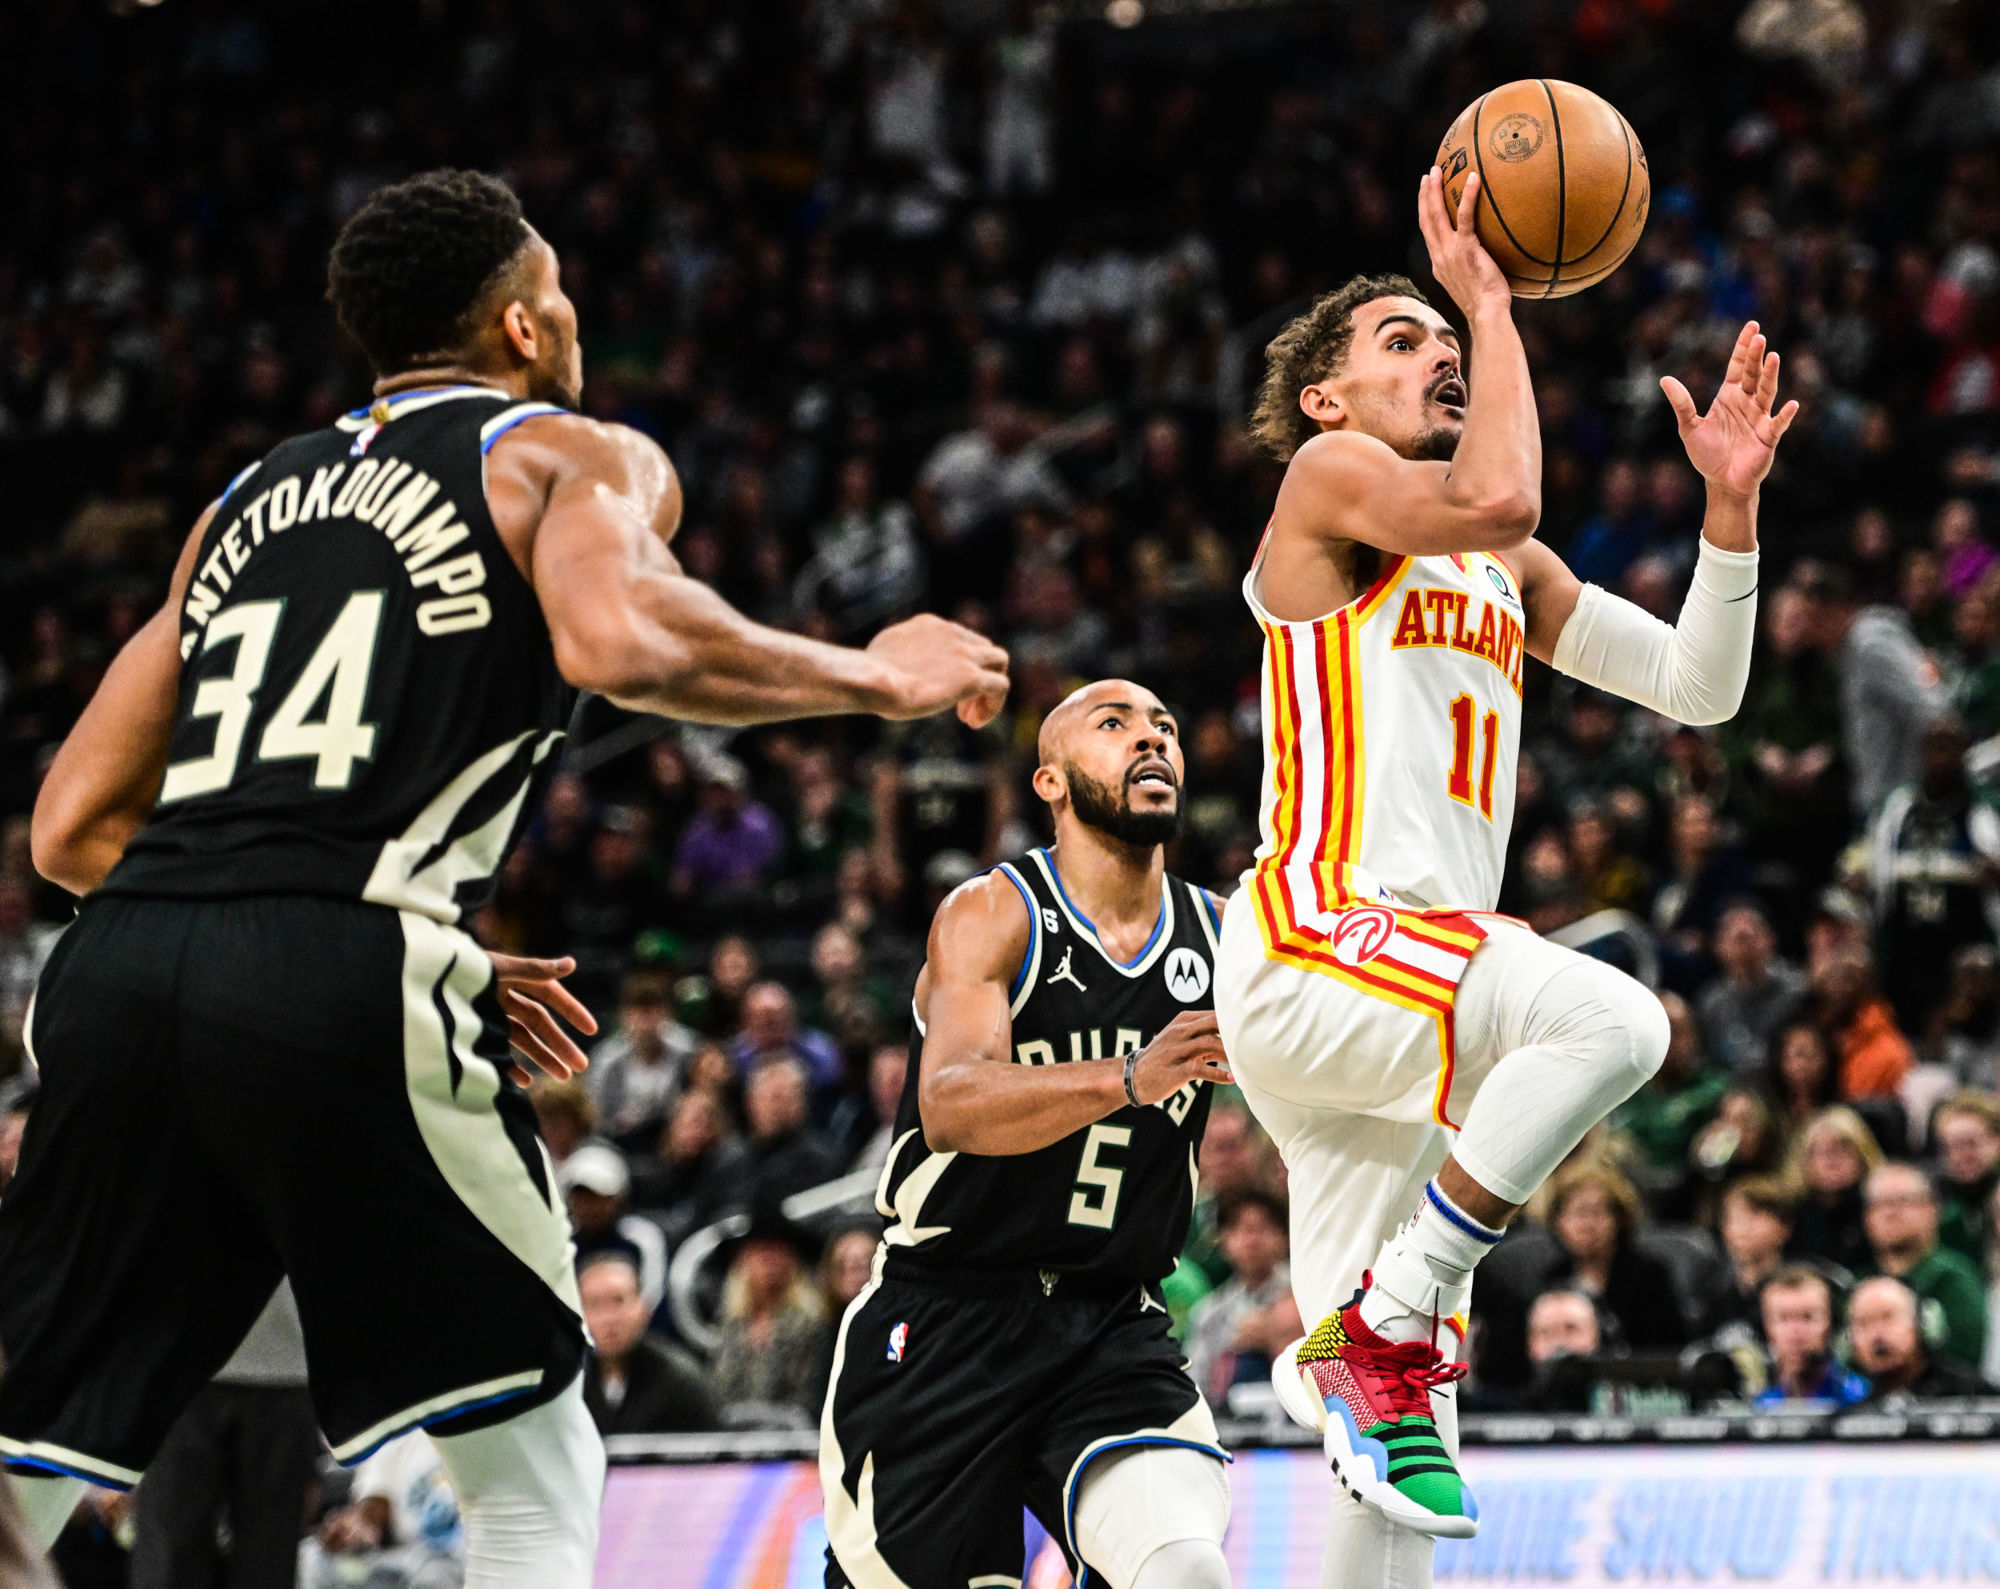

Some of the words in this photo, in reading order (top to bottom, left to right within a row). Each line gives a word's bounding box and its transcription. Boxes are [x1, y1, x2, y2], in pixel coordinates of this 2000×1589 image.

[158, 588, 387, 806] 34
[1390, 588, 1524, 704] ATLANT
[1448, 691, 1499, 824] 11
[1042, 908, 1059, 934] 6
[1066, 1122, 1135, 1230] 5
